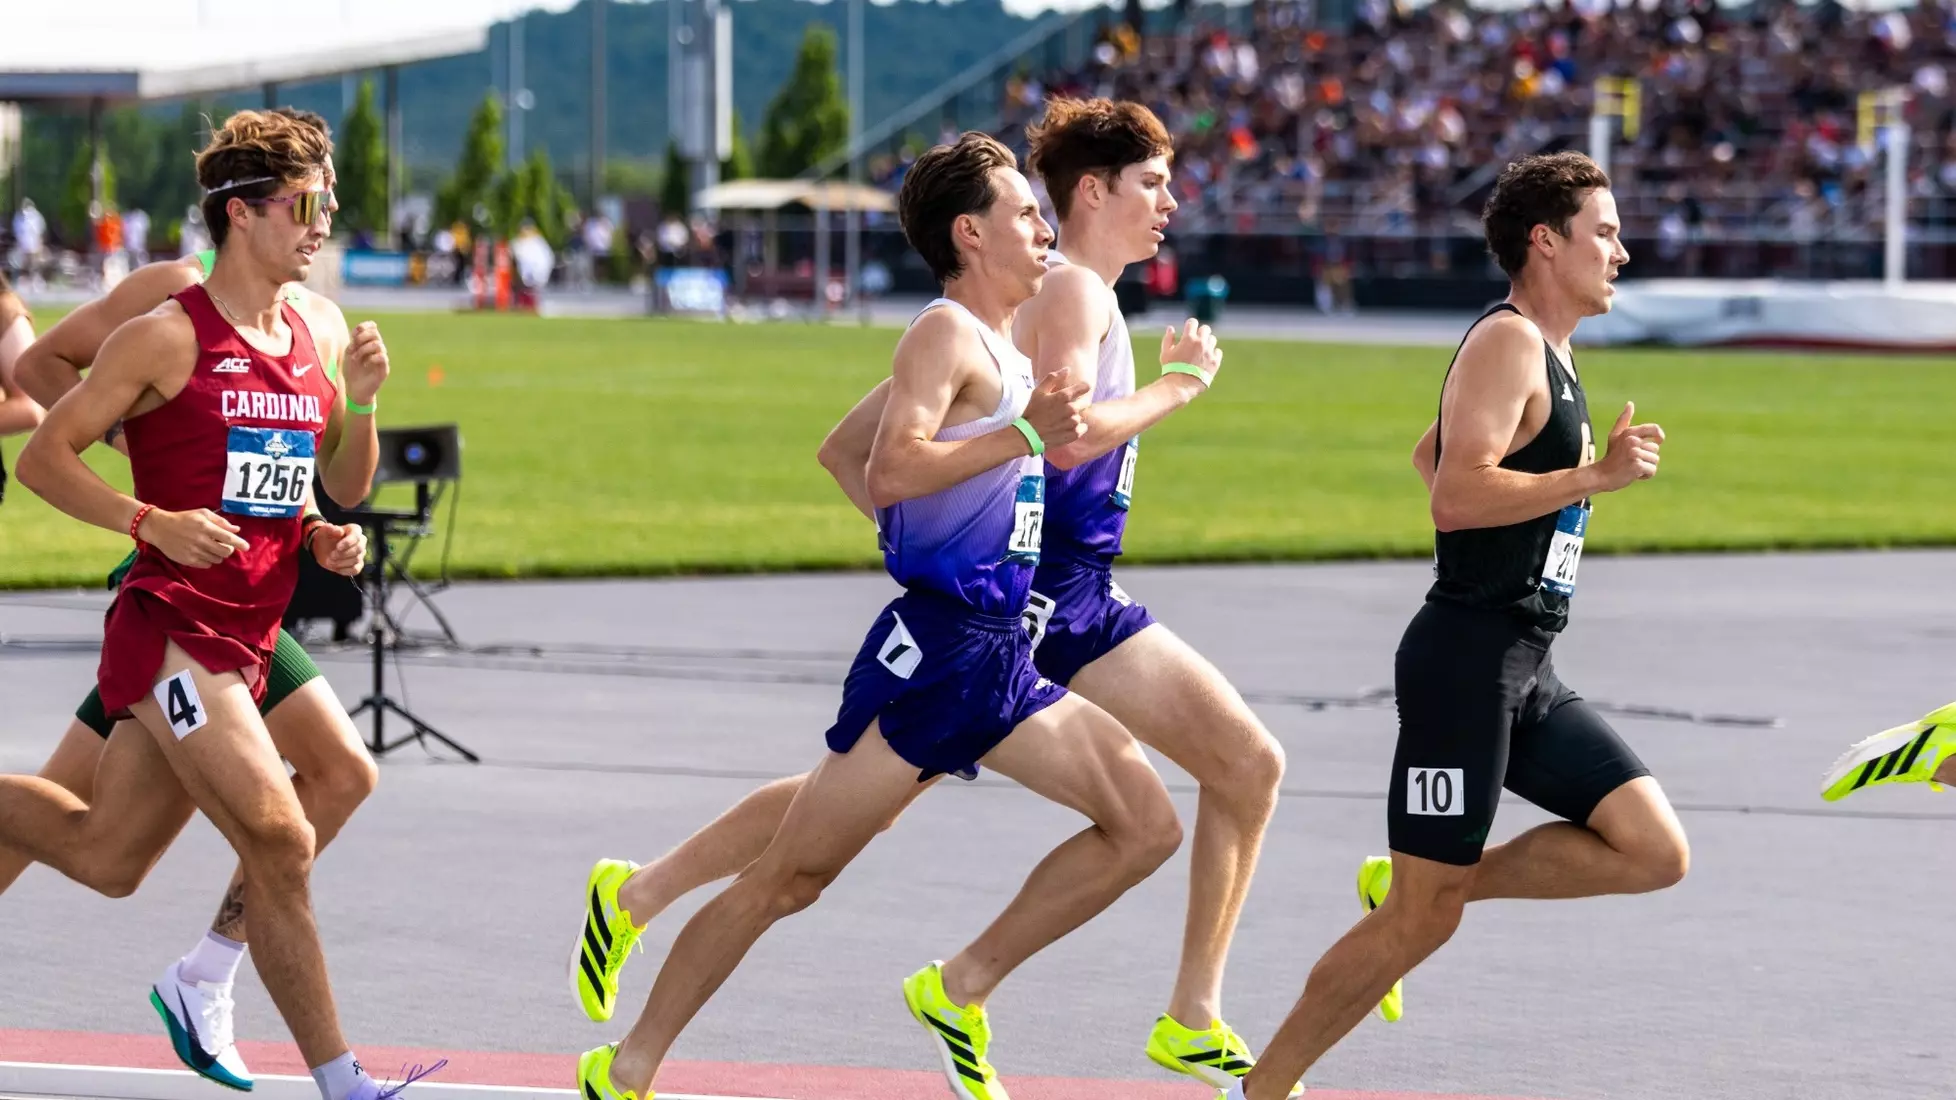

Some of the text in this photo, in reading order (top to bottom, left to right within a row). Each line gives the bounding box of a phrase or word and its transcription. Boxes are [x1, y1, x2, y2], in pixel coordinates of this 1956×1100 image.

[213, 358, 251, 373] ACC
[222, 390, 323, 423] CARDINAL
[236, 462, 307, 502] 1256
[168, 676, 197, 728] 4
[1415, 770, 1452, 813] 10
